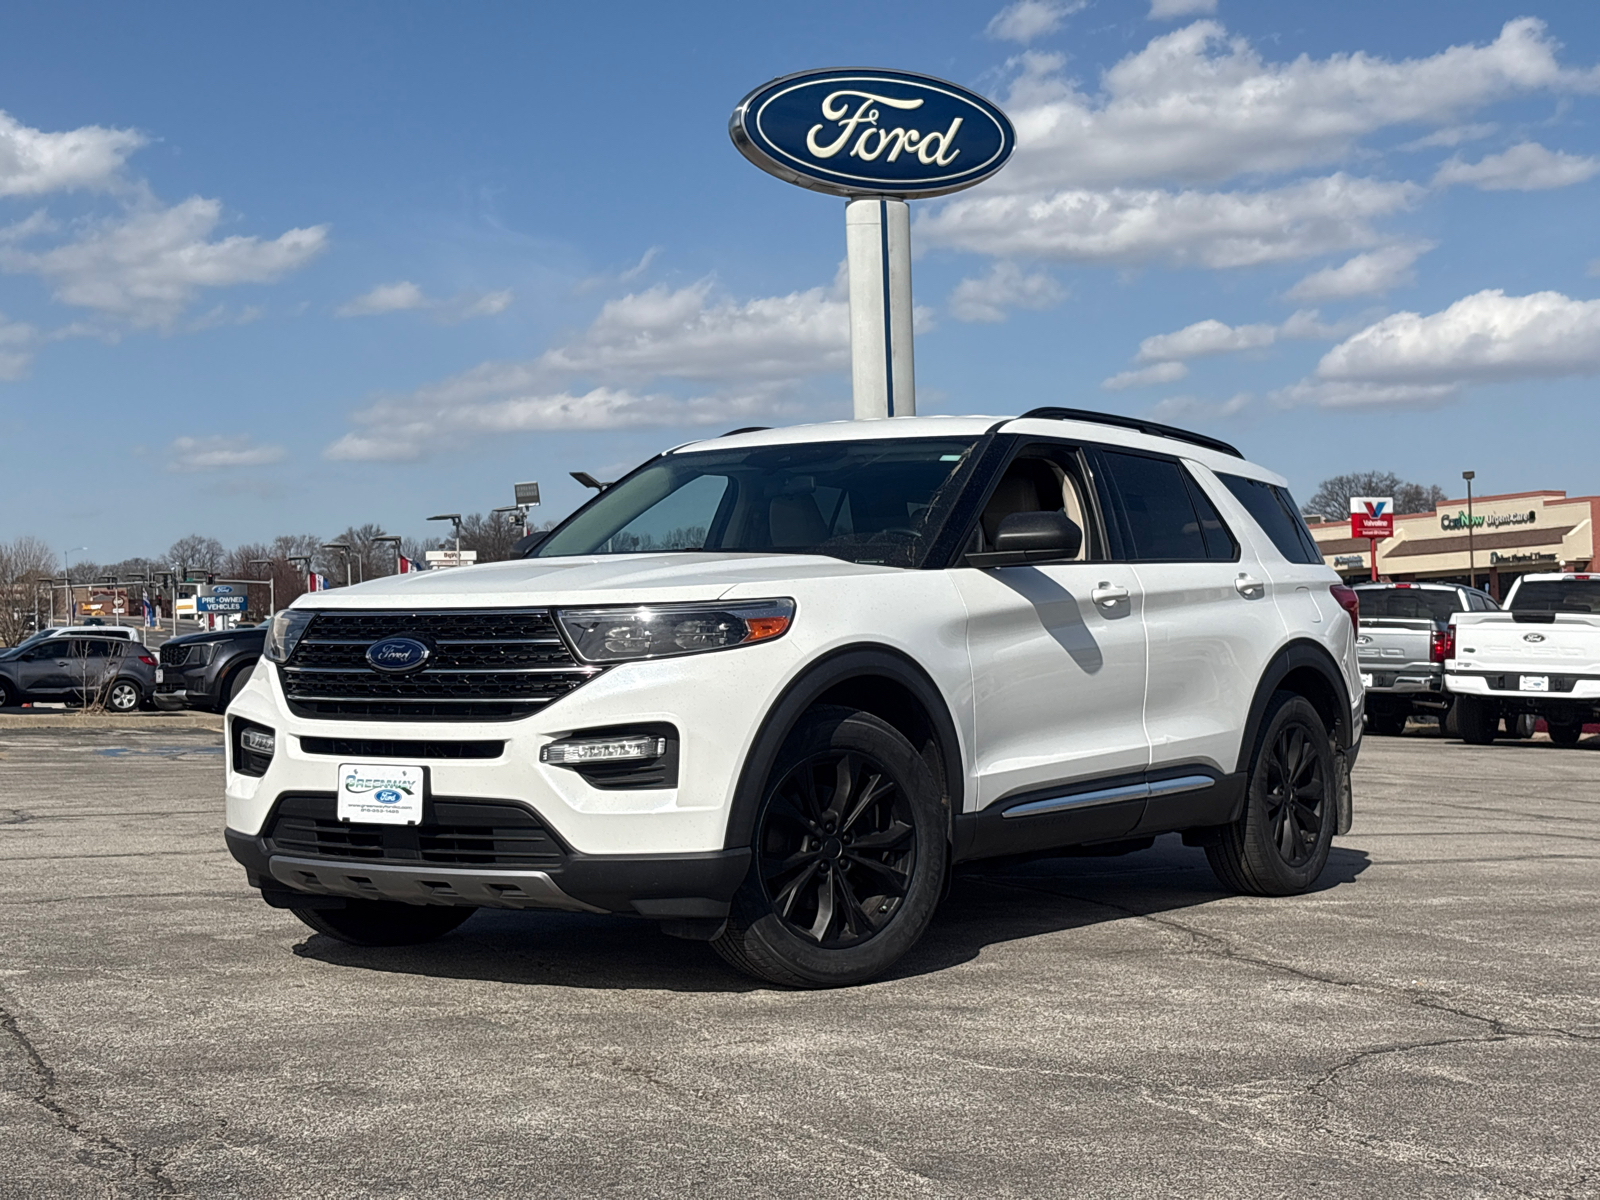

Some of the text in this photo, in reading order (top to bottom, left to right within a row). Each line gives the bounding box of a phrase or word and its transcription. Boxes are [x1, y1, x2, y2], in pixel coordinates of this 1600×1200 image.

[806, 90, 963, 167] Ford
[378, 644, 412, 661] Ford
[380, 792, 396, 801] Ford
